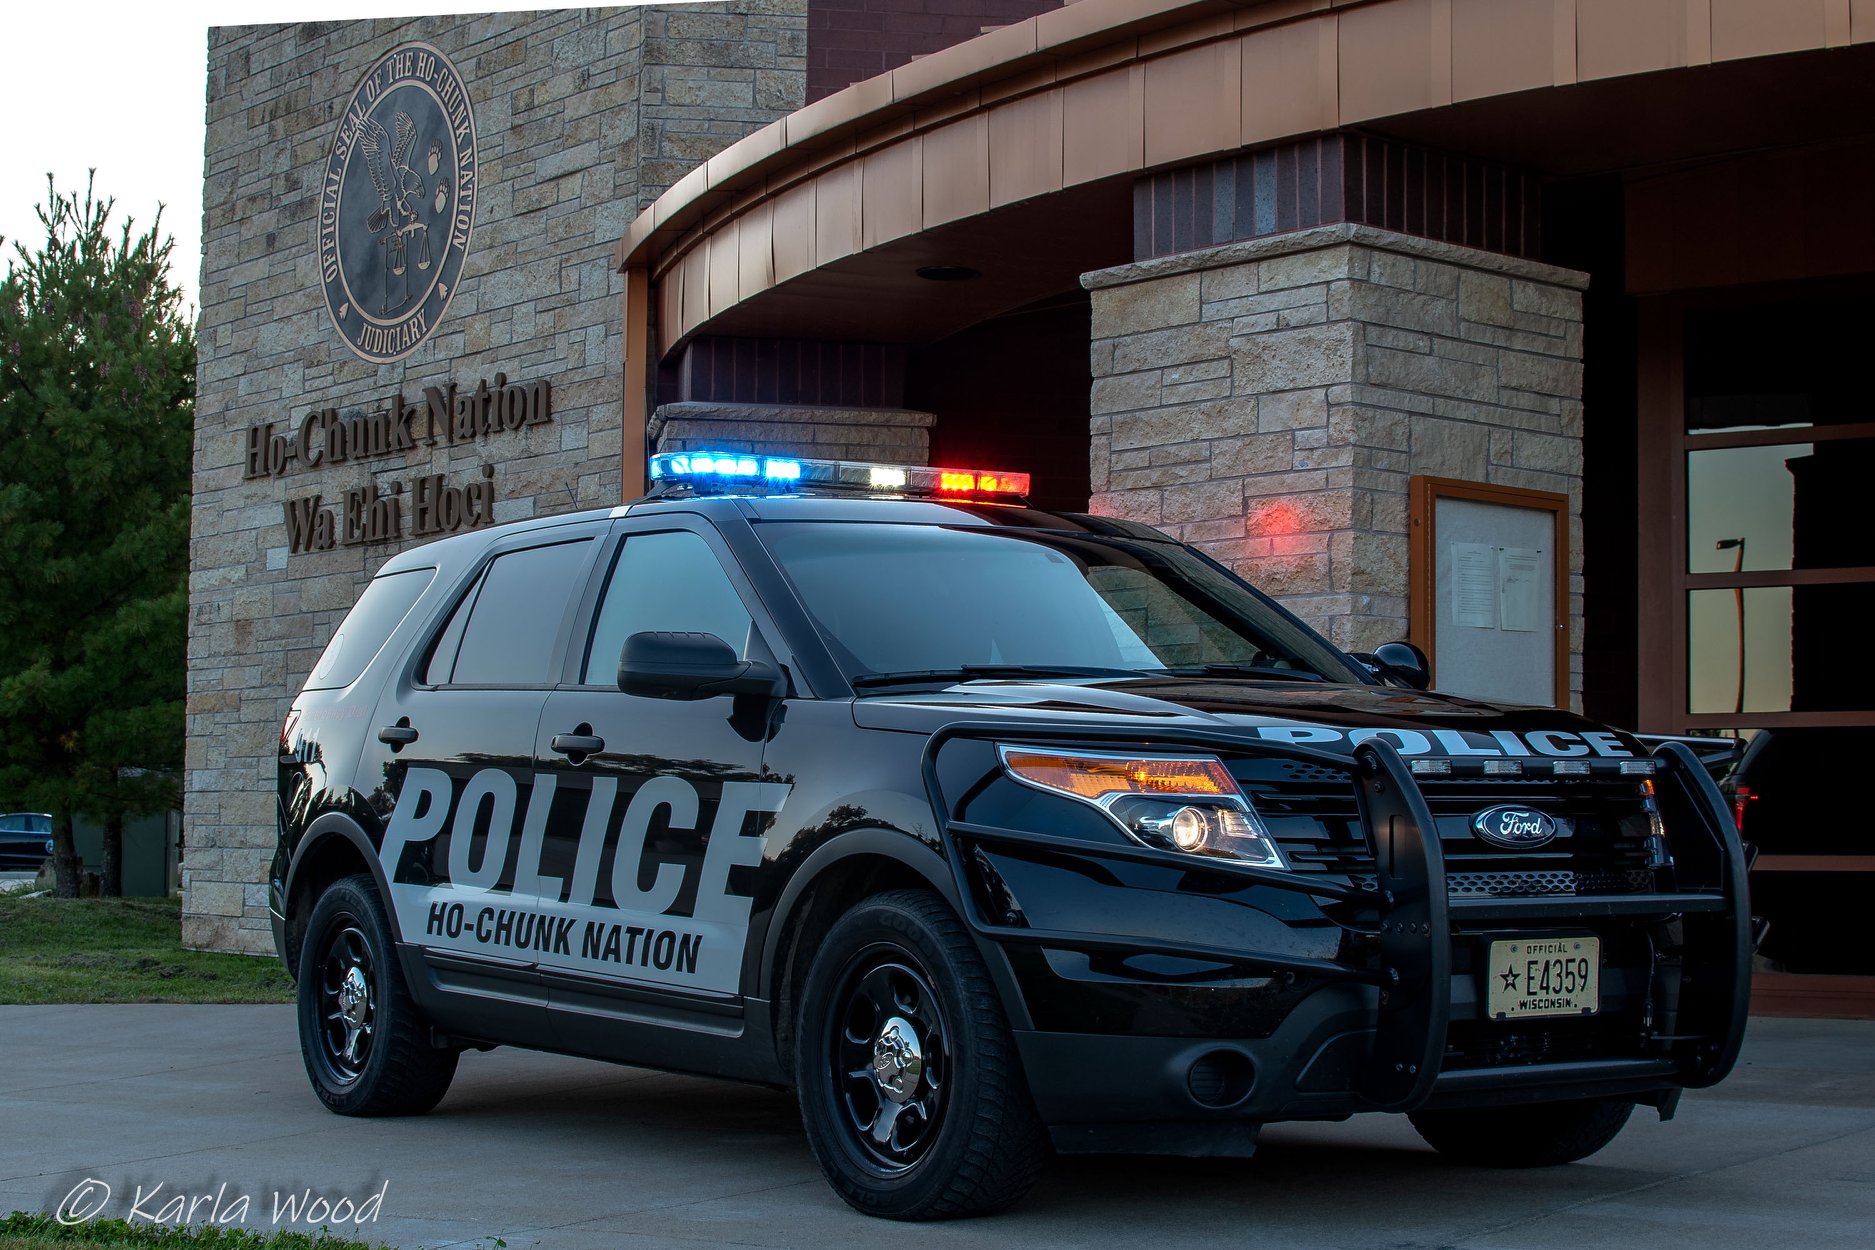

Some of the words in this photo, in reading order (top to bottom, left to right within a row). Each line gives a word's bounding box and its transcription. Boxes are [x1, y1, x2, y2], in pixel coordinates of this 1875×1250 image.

[322, 167, 344, 284] OFFICIAL
[335, 99, 368, 160] SEAL
[365, 75, 384, 103] OF
[385, 51, 415, 85] THE
[415, 51, 472, 144] HO-CHUNK
[455, 149, 476, 251] NATION
[356, 309, 428, 354] JUDICIARY
[243, 394, 416, 480] Ho-Chunk
[421, 372, 552, 446] Nation
[283, 494, 336, 553] Wa
[341, 480, 402, 546] Ehi
[409, 465, 495, 537] Hoci
[295, 727, 320, 763] 911
[1257, 727, 1635, 757] POLICE
[379, 767, 794, 920] POLICE
[1499, 811, 1543, 835] Ford
[426, 901, 578, 957] HO-CHUNK
[581, 922, 704, 975] NATION
[1526, 943, 1568, 955] OFFICIAL
[1526, 957, 1589, 997] E4359
[1519, 997, 1572, 1011] WISCONSIN
